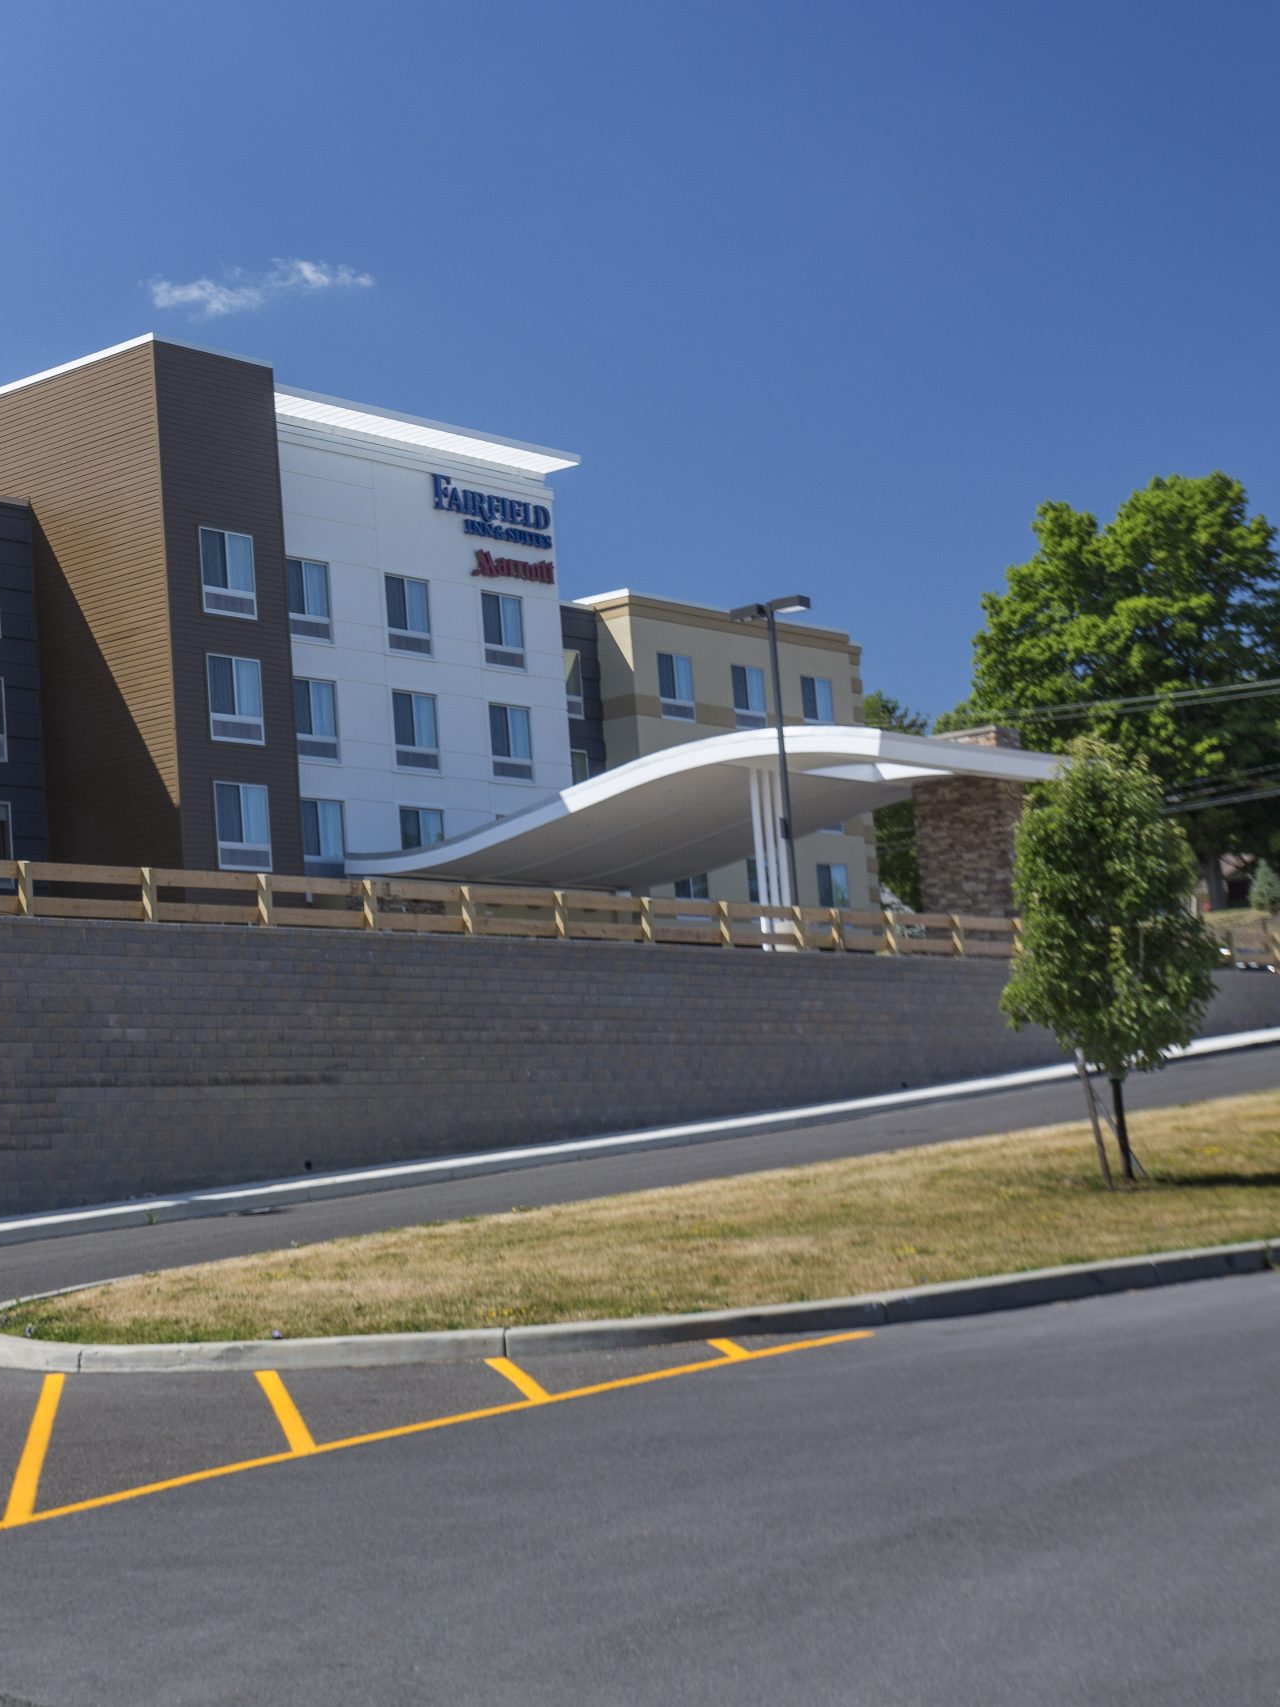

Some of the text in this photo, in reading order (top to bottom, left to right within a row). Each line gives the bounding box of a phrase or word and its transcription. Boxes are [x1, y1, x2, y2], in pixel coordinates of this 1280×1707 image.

[431, 473, 551, 530] FAIRFIELD
[464, 519, 495, 538] INN
[505, 528, 553, 549] SUITES
[471, 549, 555, 585] Marriott
